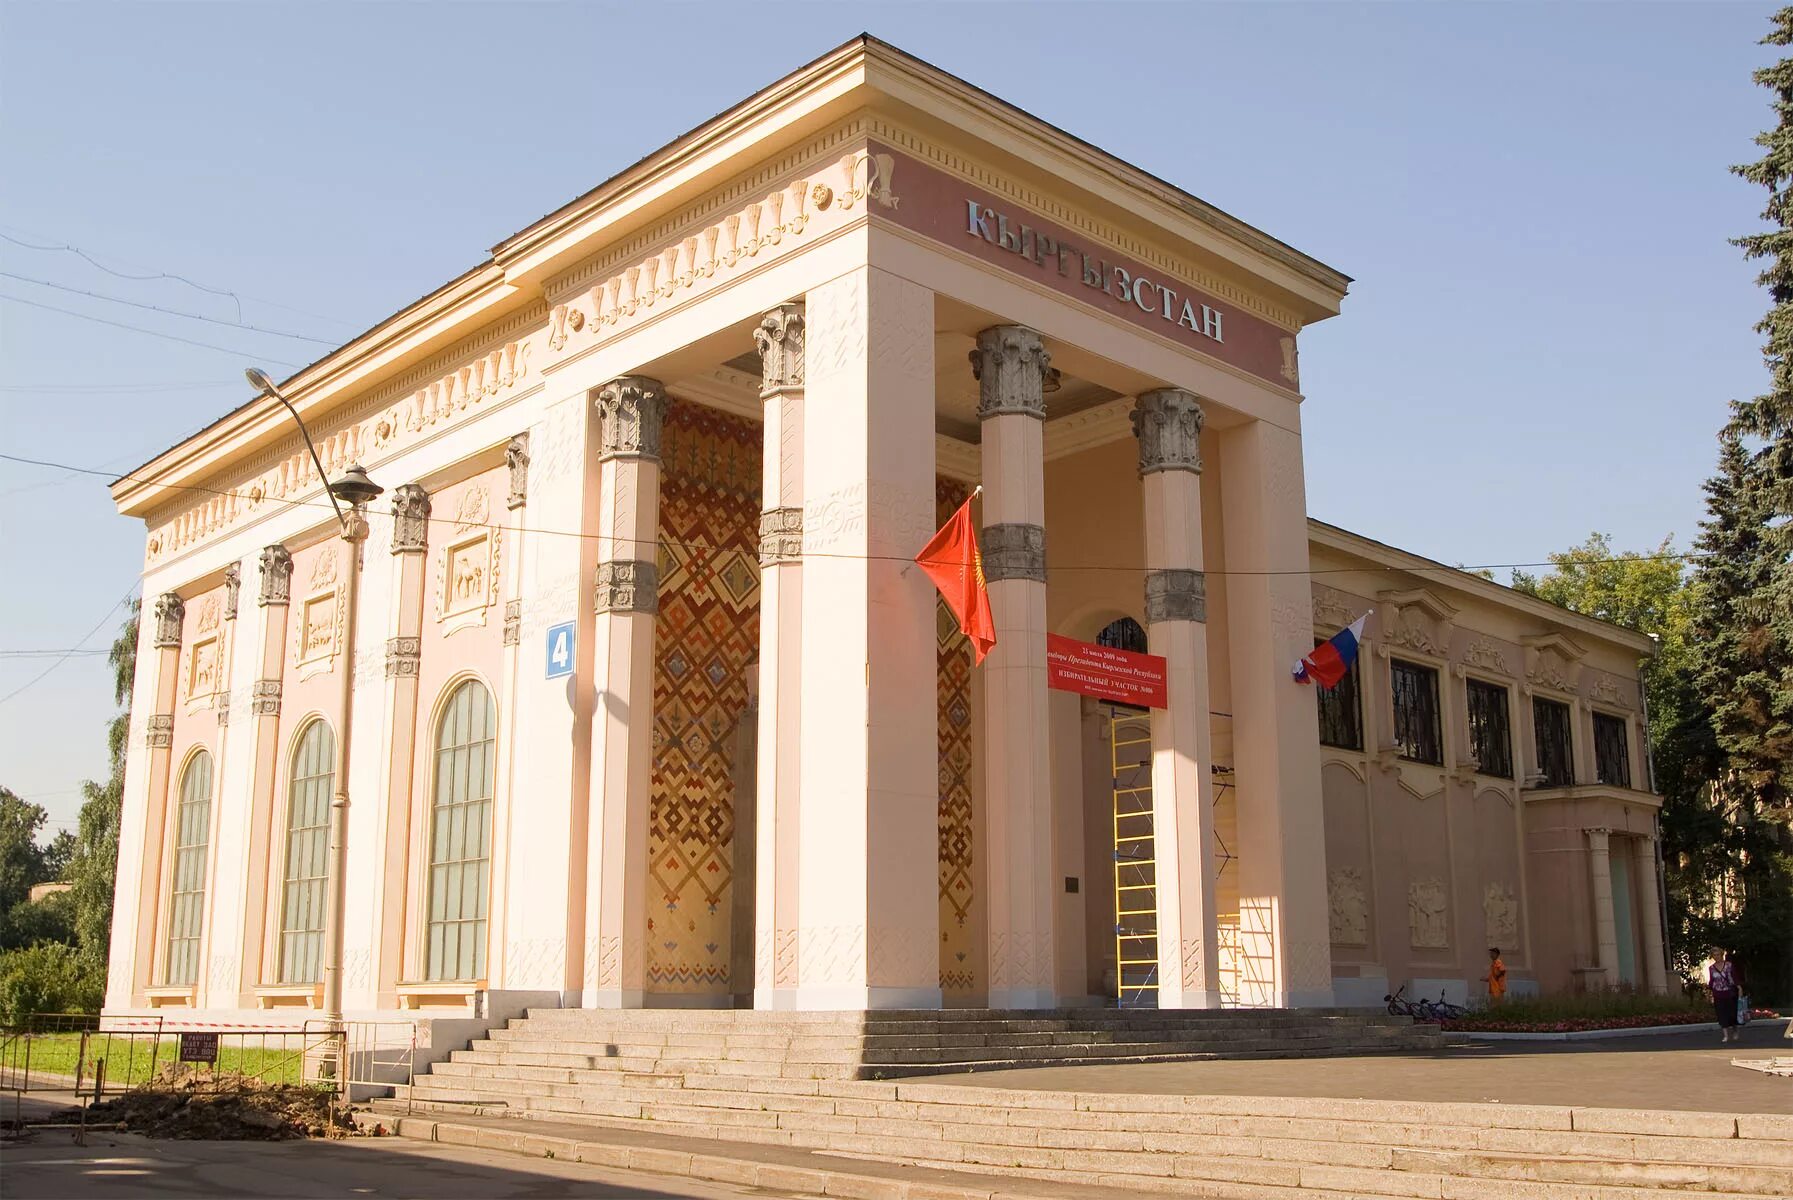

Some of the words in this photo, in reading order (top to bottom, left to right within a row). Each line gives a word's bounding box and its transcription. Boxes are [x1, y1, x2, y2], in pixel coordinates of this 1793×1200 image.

[964, 198, 1225, 344] КЫРГЫЗСТАН
[551, 631, 568, 668] 4
[1067, 654, 1102, 668] Президента
[1058, 669, 1109, 686] ИЗБИРАТЕЛЬНЫЙ
[1110, 679, 1138, 692] УЧАСТОК
